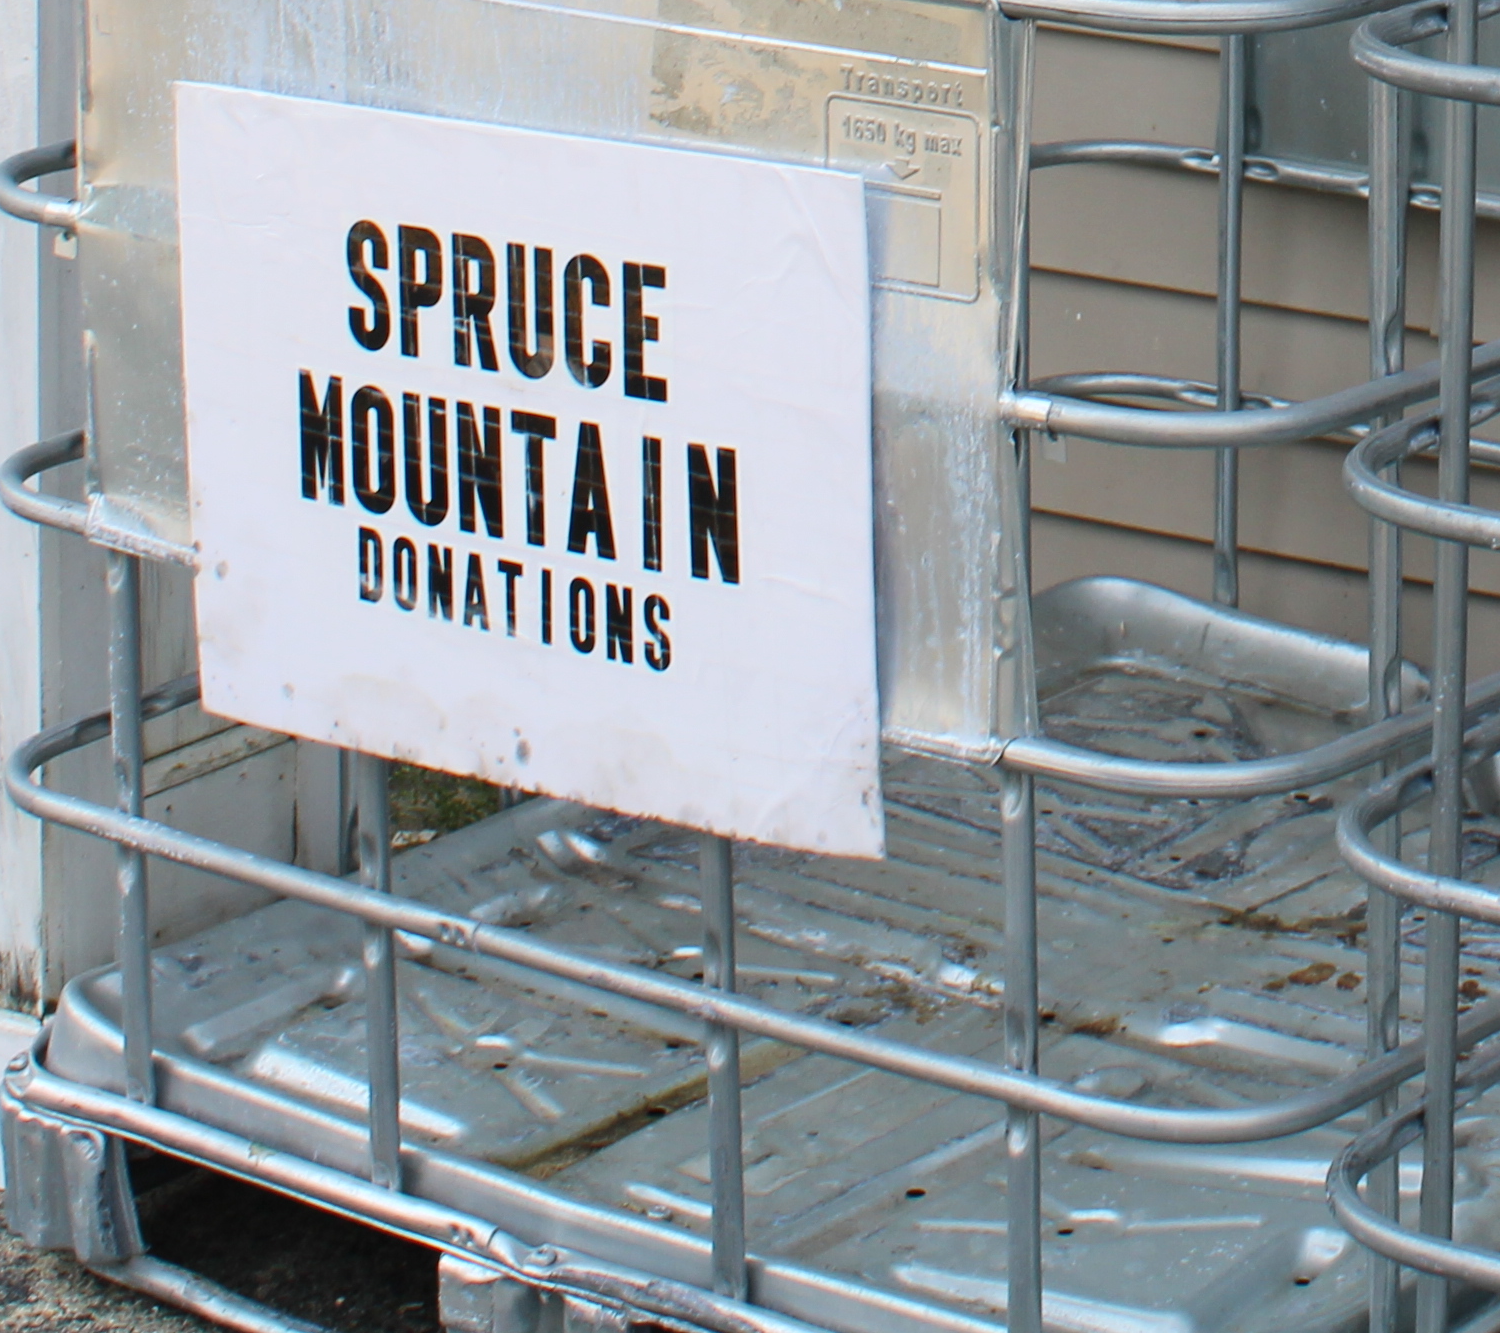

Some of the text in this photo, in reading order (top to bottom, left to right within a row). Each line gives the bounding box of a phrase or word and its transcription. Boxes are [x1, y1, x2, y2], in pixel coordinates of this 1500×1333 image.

[839, 63, 964, 107] Transport
[842, 112, 963, 156] 1650 kg max
[344, 218, 668, 403] SPRUCE
[298, 367, 741, 586] MOUNTAIN
[357, 525, 673, 672] DONATIONS
